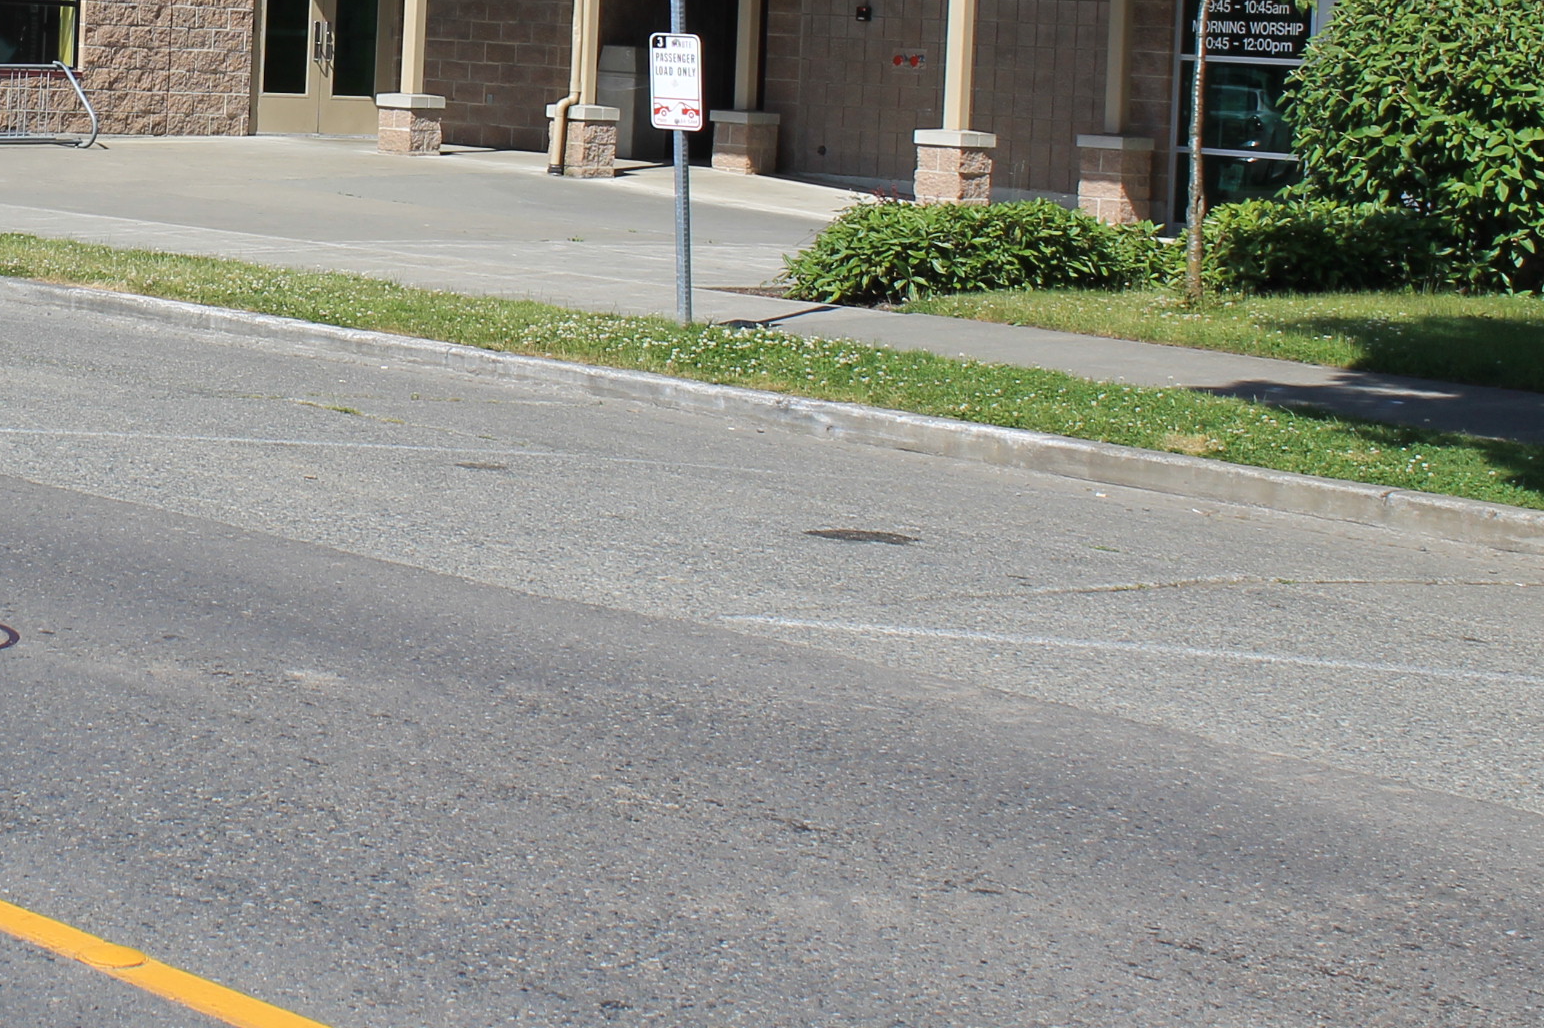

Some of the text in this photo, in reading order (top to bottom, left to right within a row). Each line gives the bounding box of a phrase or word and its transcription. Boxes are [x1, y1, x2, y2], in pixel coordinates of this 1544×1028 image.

[1208, 0, 1231, 13] 9:45
[1244, 0, 1290, 15] 10:45am
[1249, 22, 1304, 36] WORSHIP
[656, 36, 664, 48] 3
[1204, 36, 1230, 50] 0:45
[1243, 37, 1293, 55] 12:00pm
[655, 52, 696, 64] PASSENGER
[655, 66, 696, 77] LOAD ONLY
